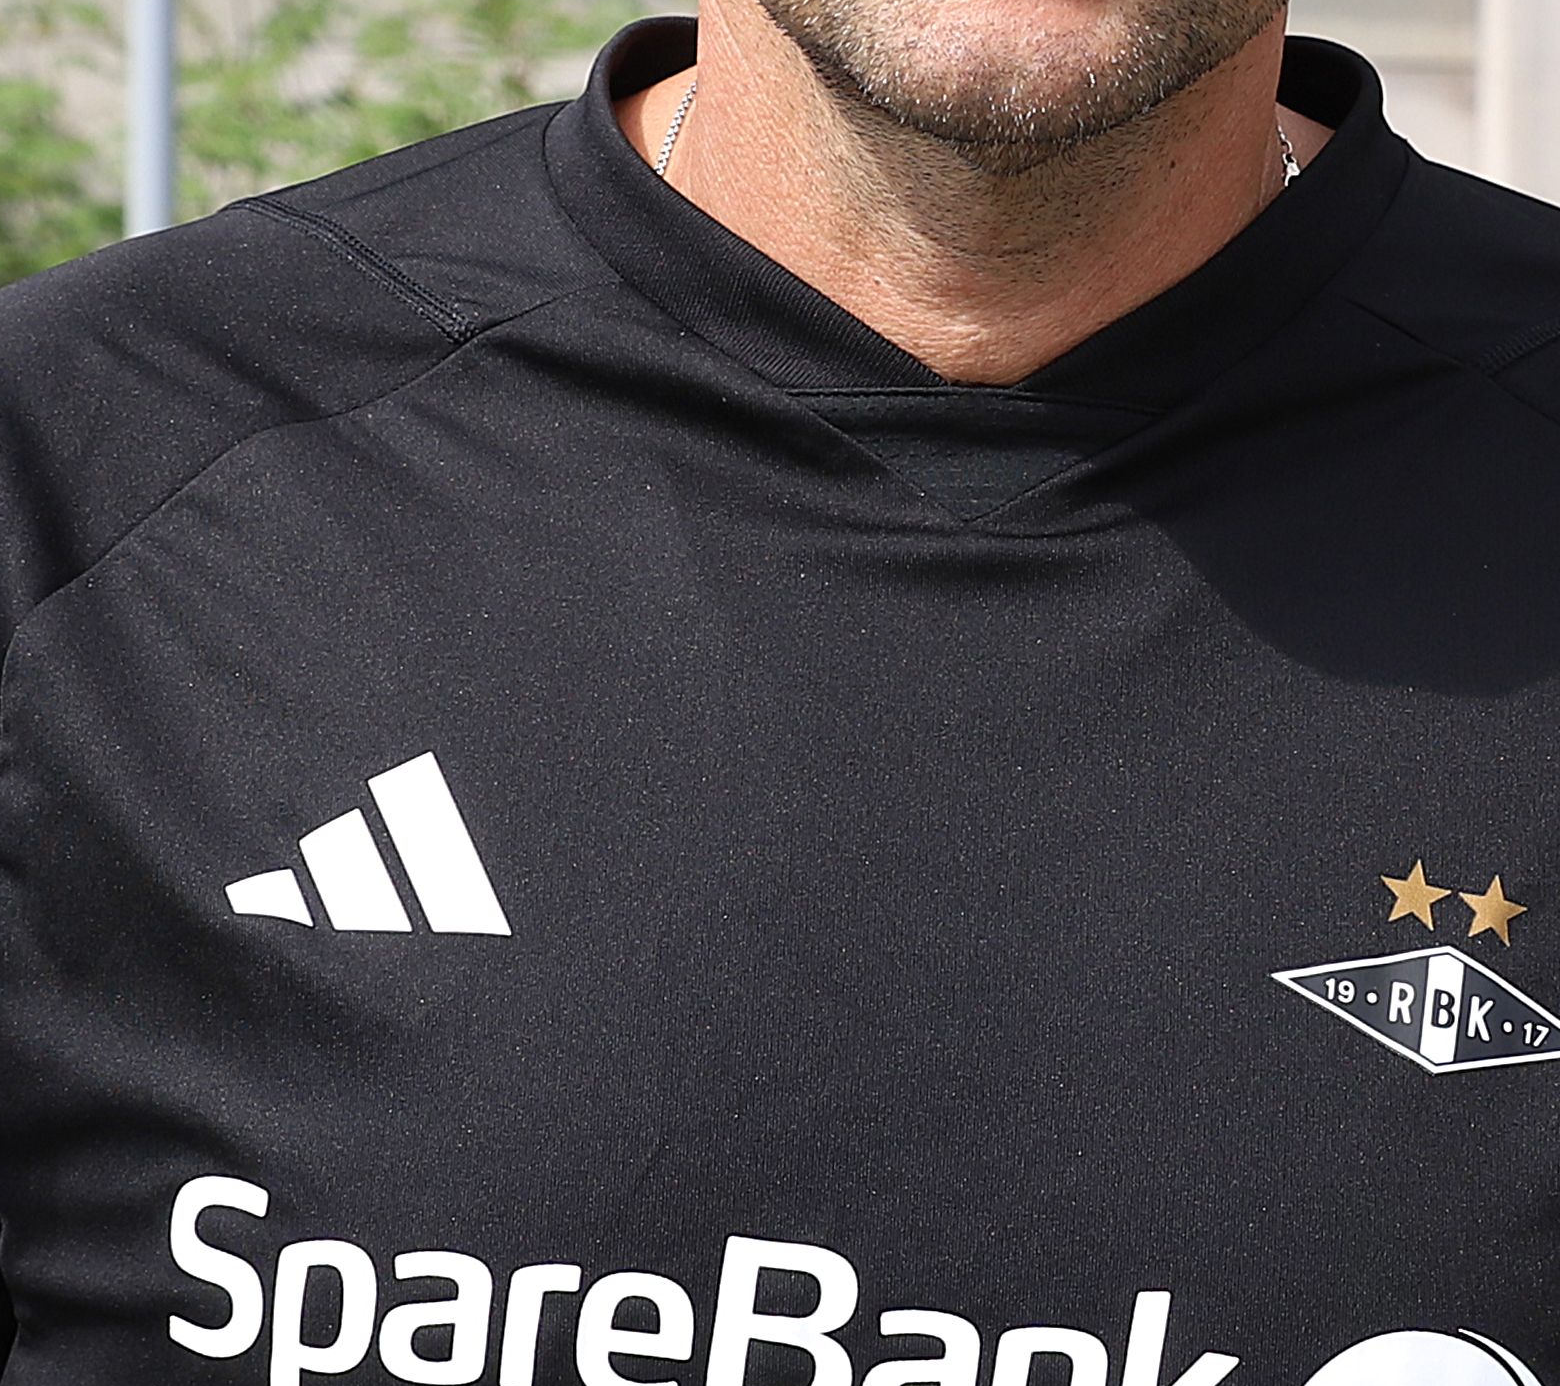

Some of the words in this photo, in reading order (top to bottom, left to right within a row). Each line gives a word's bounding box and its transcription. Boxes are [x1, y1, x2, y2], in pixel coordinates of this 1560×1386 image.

[1325, 977, 1356, 1004] 19
[1389, 981, 1494, 1042] RBK
[1522, 1022, 1550, 1048] 17
